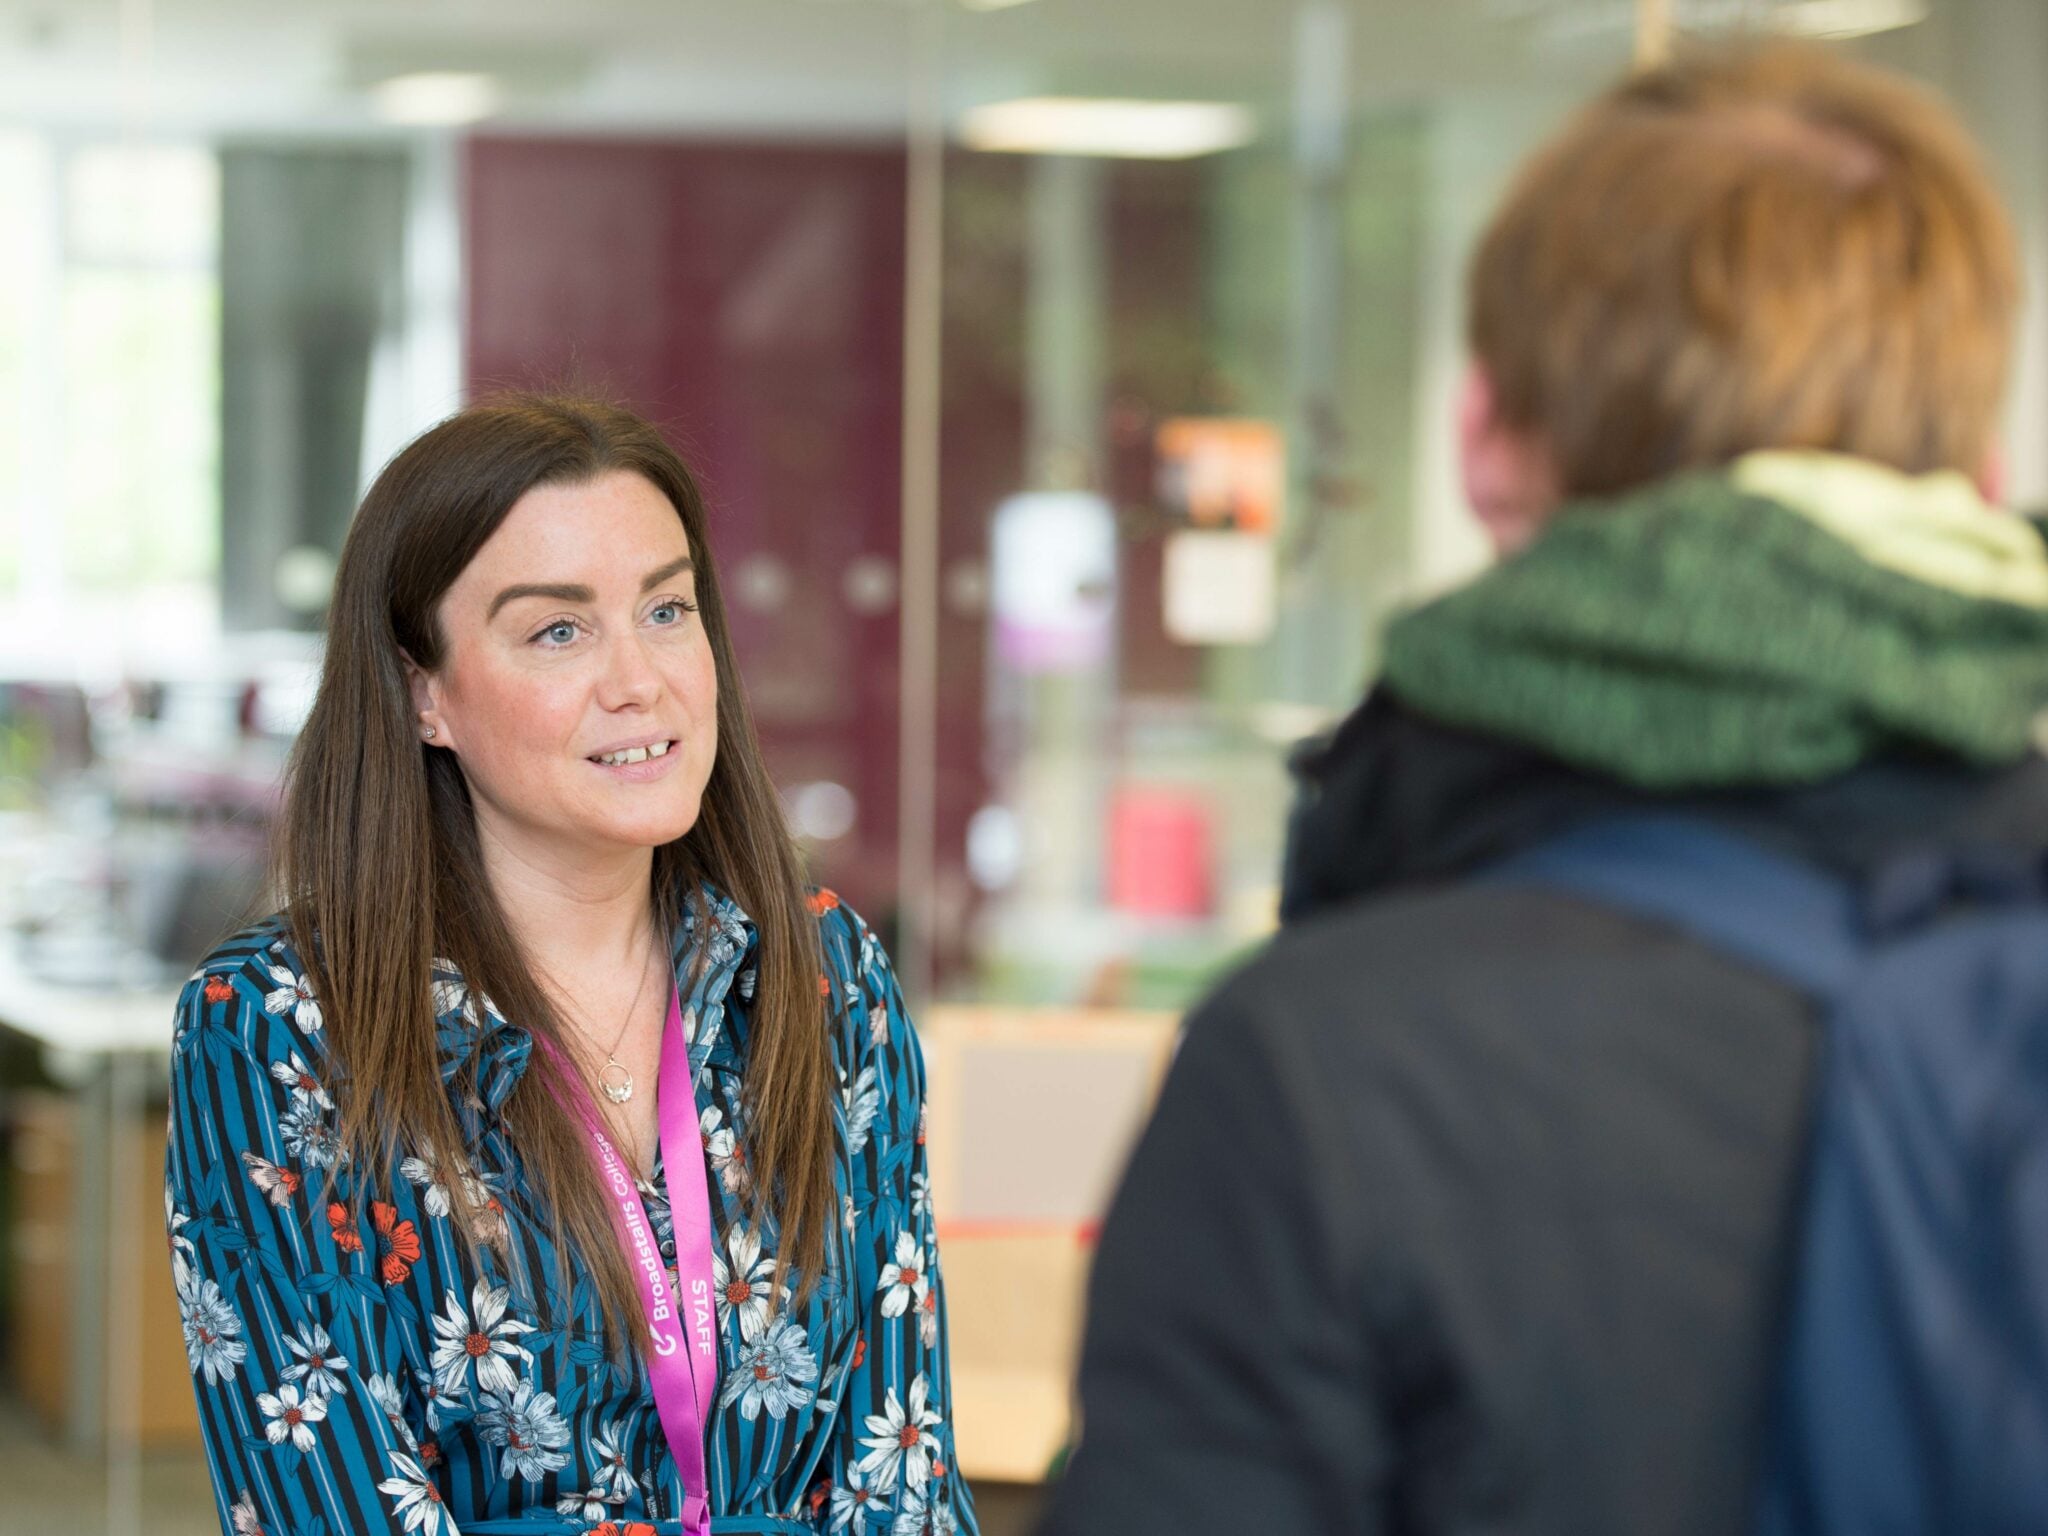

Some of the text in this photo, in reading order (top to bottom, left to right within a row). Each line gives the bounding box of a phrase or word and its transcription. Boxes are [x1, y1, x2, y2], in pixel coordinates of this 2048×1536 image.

[593, 1131, 669, 1322] Broadstairs College
[692, 1279, 711, 1356] STAFF
